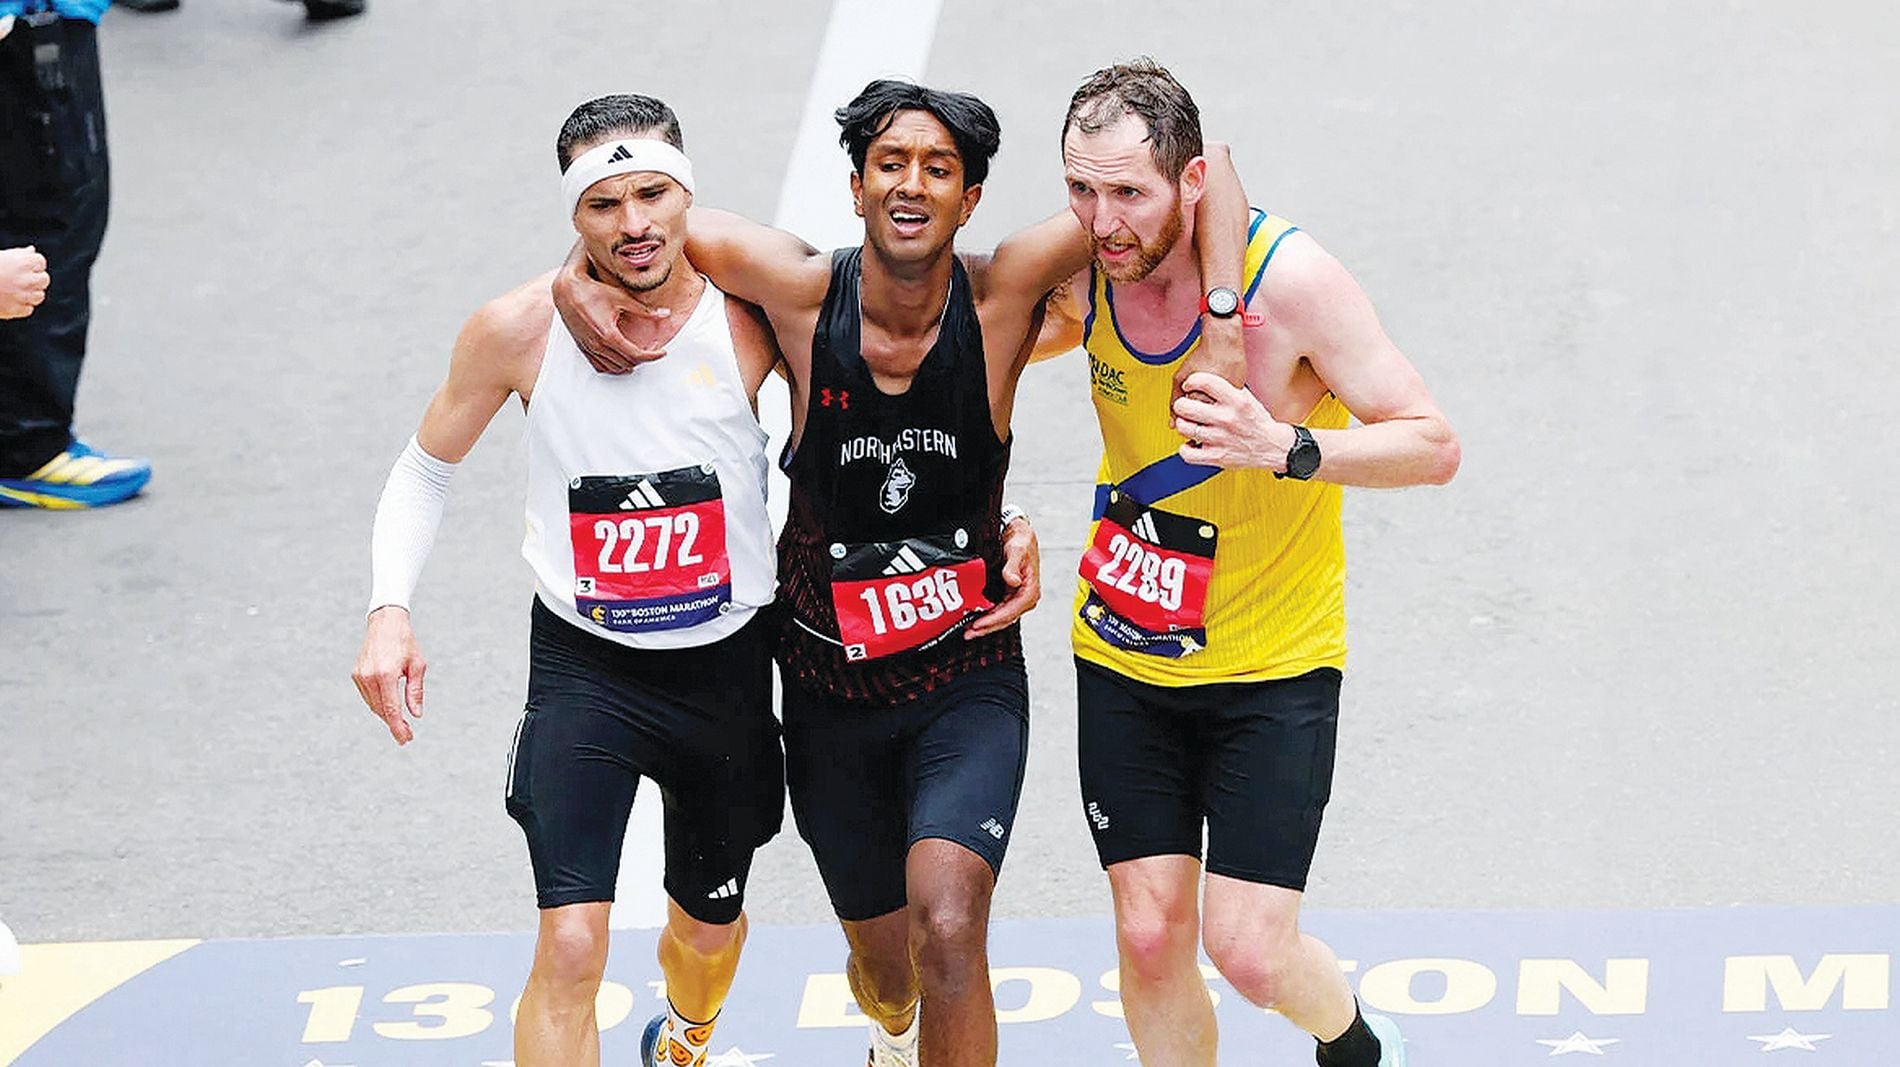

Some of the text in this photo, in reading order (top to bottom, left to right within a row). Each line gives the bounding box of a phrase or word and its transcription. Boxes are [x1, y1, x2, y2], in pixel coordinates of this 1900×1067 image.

[840, 428, 957, 466] NORHASTERN
[593, 512, 703, 573] 2272
[580, 580, 592, 593] 3
[1096, 533, 1186, 611] 2289
[633, 604, 668, 617] BOSTON
[669, 595, 719, 613] MARATHON
[859, 567, 964, 636] 1636
[849, 646, 864, 658] 2
